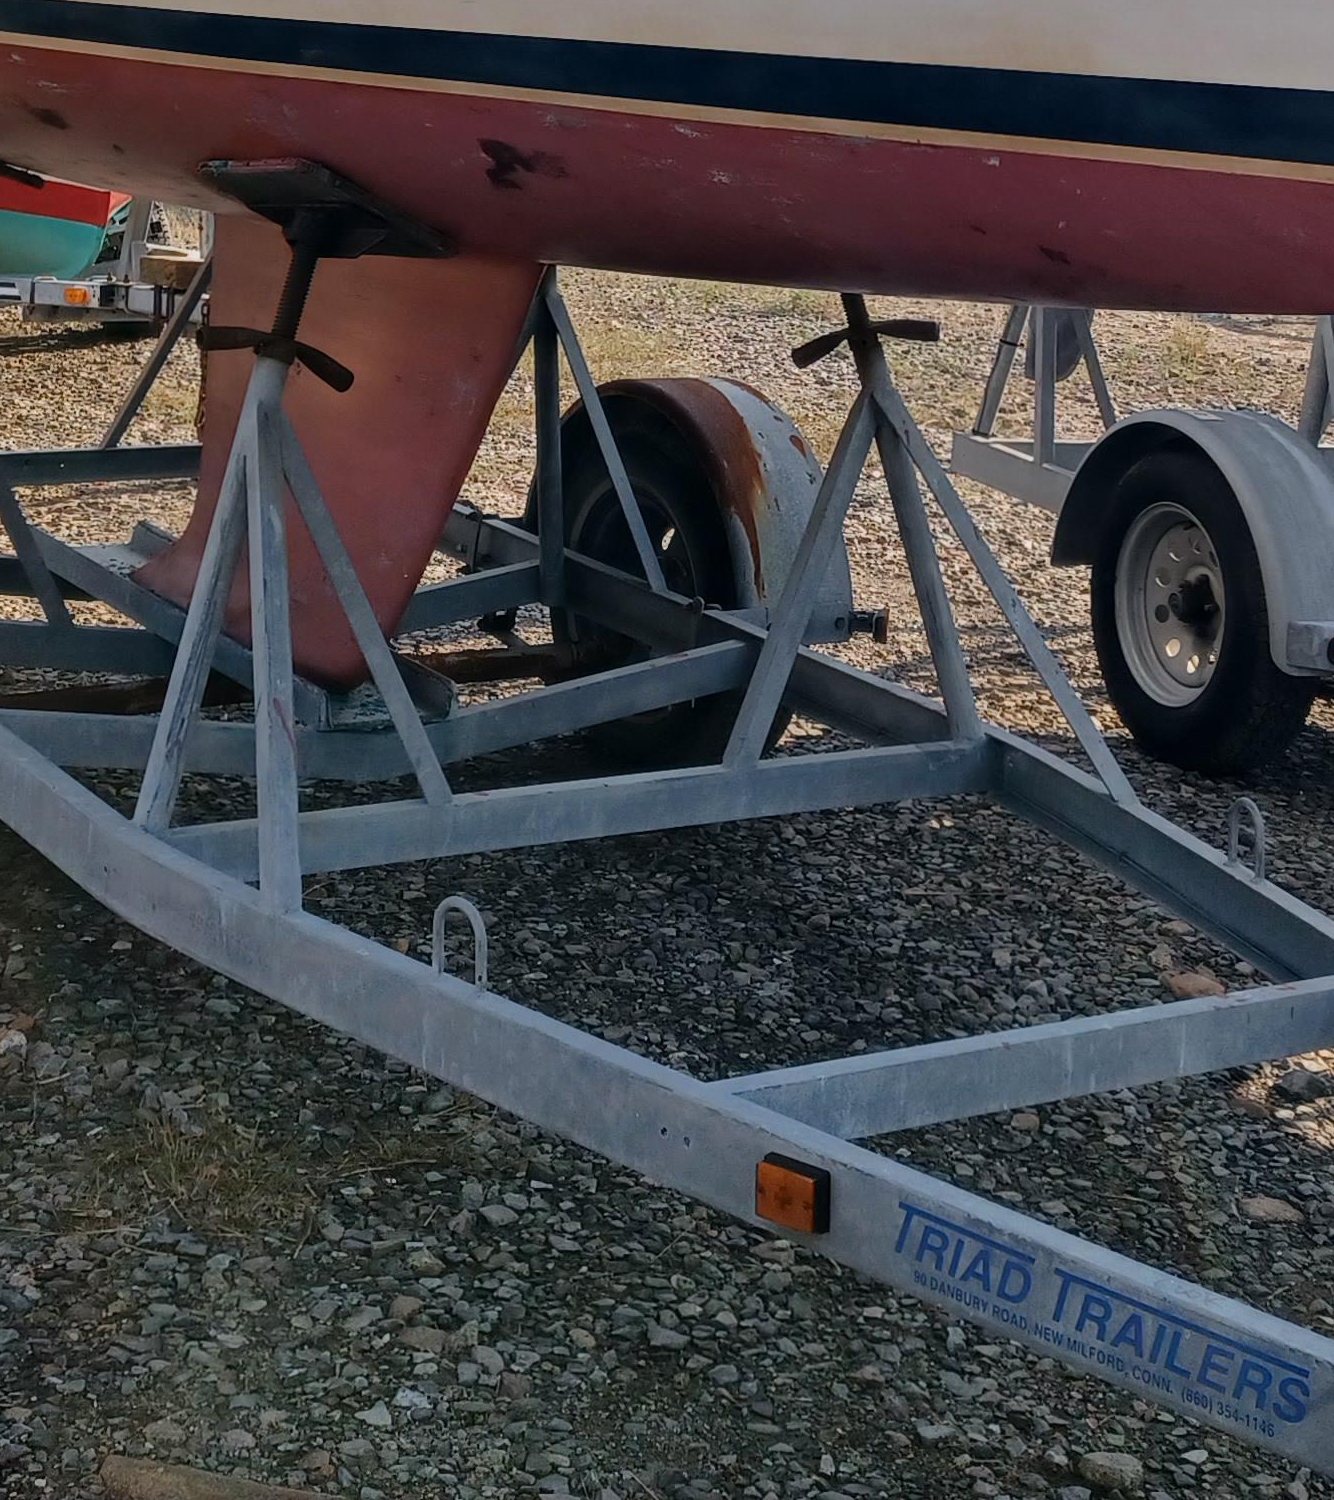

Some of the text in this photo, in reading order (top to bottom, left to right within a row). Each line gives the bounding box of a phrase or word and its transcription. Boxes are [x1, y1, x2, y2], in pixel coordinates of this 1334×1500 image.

[894, 1201, 1310, 1424] TRIAD TRAILERS
[930, 1276, 989, 1313] DANBURY
[1034, 1322, 1064, 1346] NEW
[1217, 1400, 1275, 1438] 354-1146
